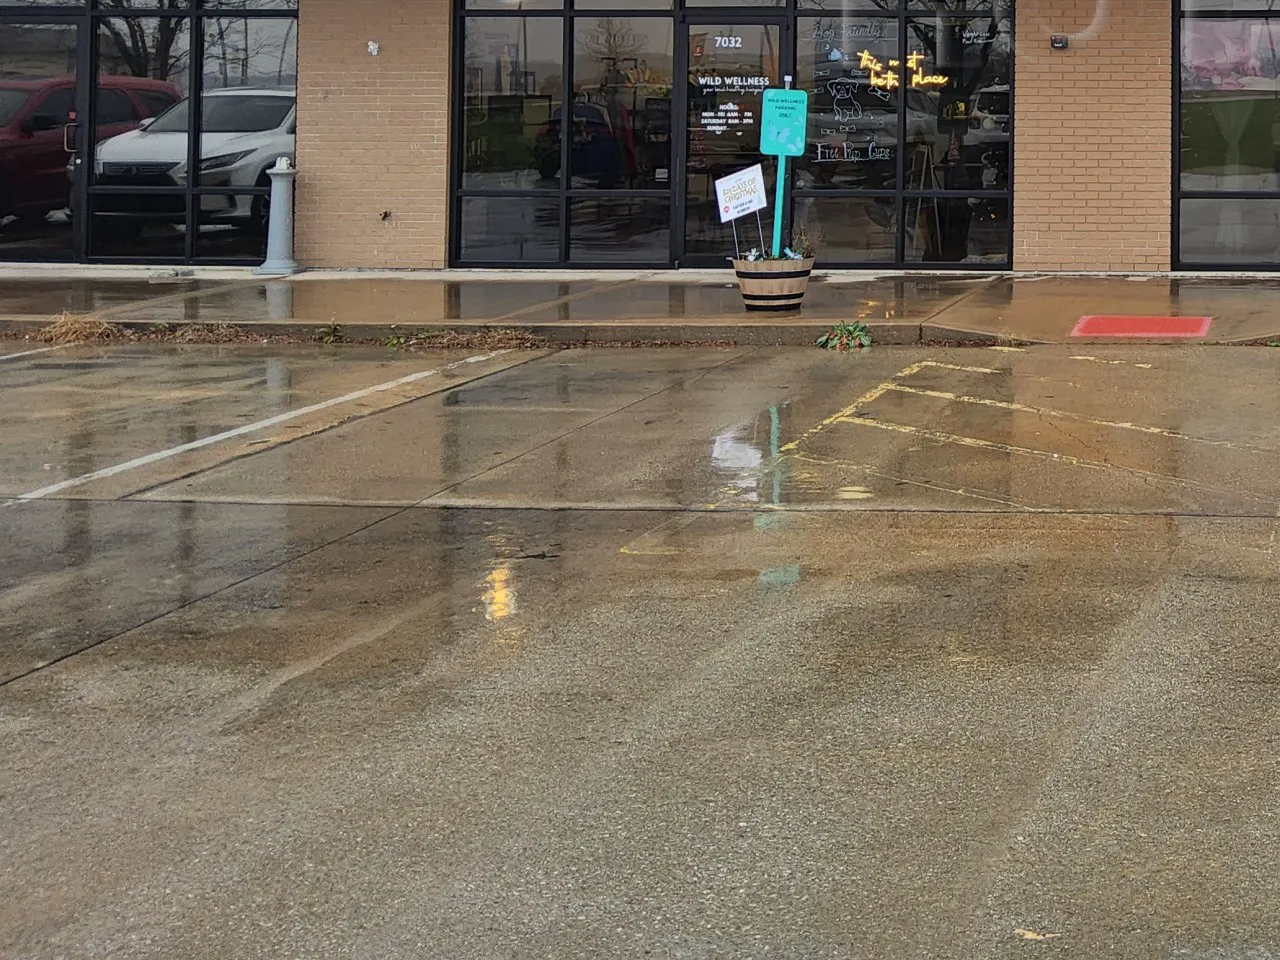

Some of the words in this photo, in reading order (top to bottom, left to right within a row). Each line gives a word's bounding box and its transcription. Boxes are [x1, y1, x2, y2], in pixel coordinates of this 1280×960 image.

[714, 36, 742, 48] 7032
[857, 49, 882, 71] this
[698, 77, 722, 86] WILD
[724, 76, 770, 86] WELLNESS
[912, 67, 949, 87] place
[815, 142, 839, 160] Free
[842, 141, 861, 162] Pup
